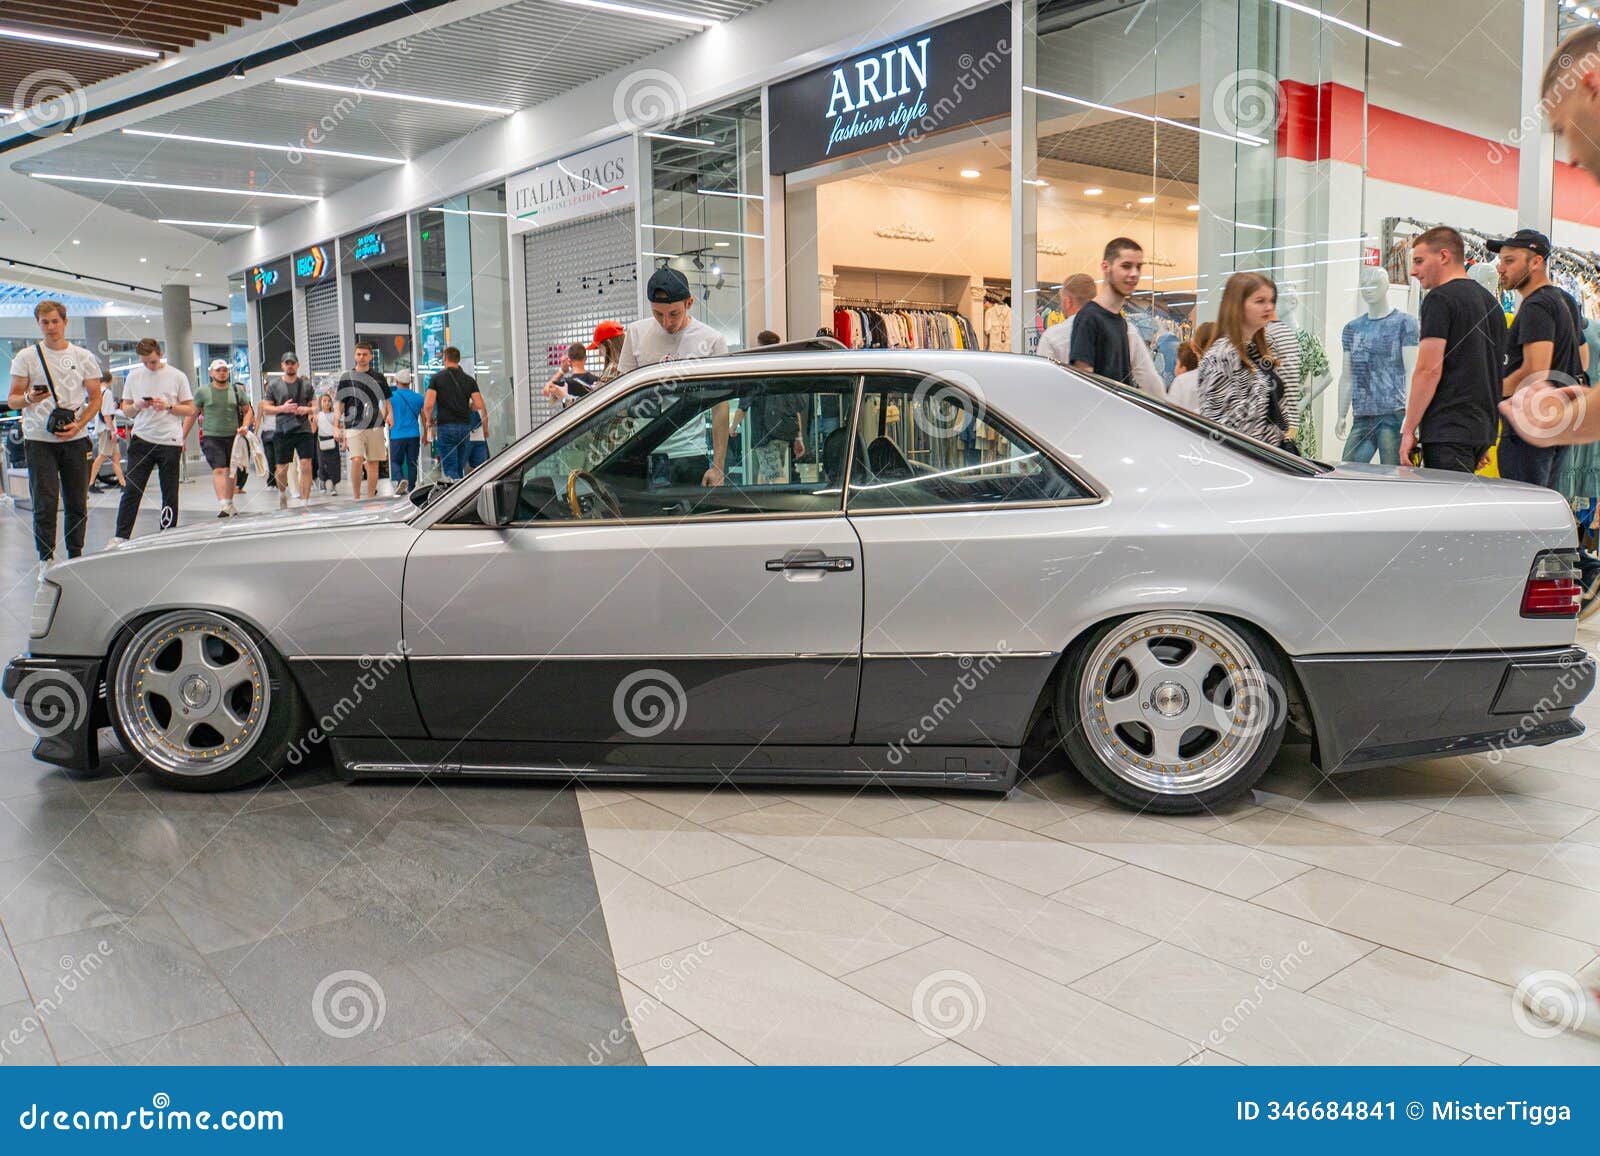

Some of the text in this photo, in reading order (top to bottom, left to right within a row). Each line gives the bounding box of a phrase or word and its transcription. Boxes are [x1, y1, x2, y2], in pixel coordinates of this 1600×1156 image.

[825, 38, 931, 119] ARIN
[825, 90, 928, 156] fashion style
[515, 157, 625, 211] ITALIAN BAGS
